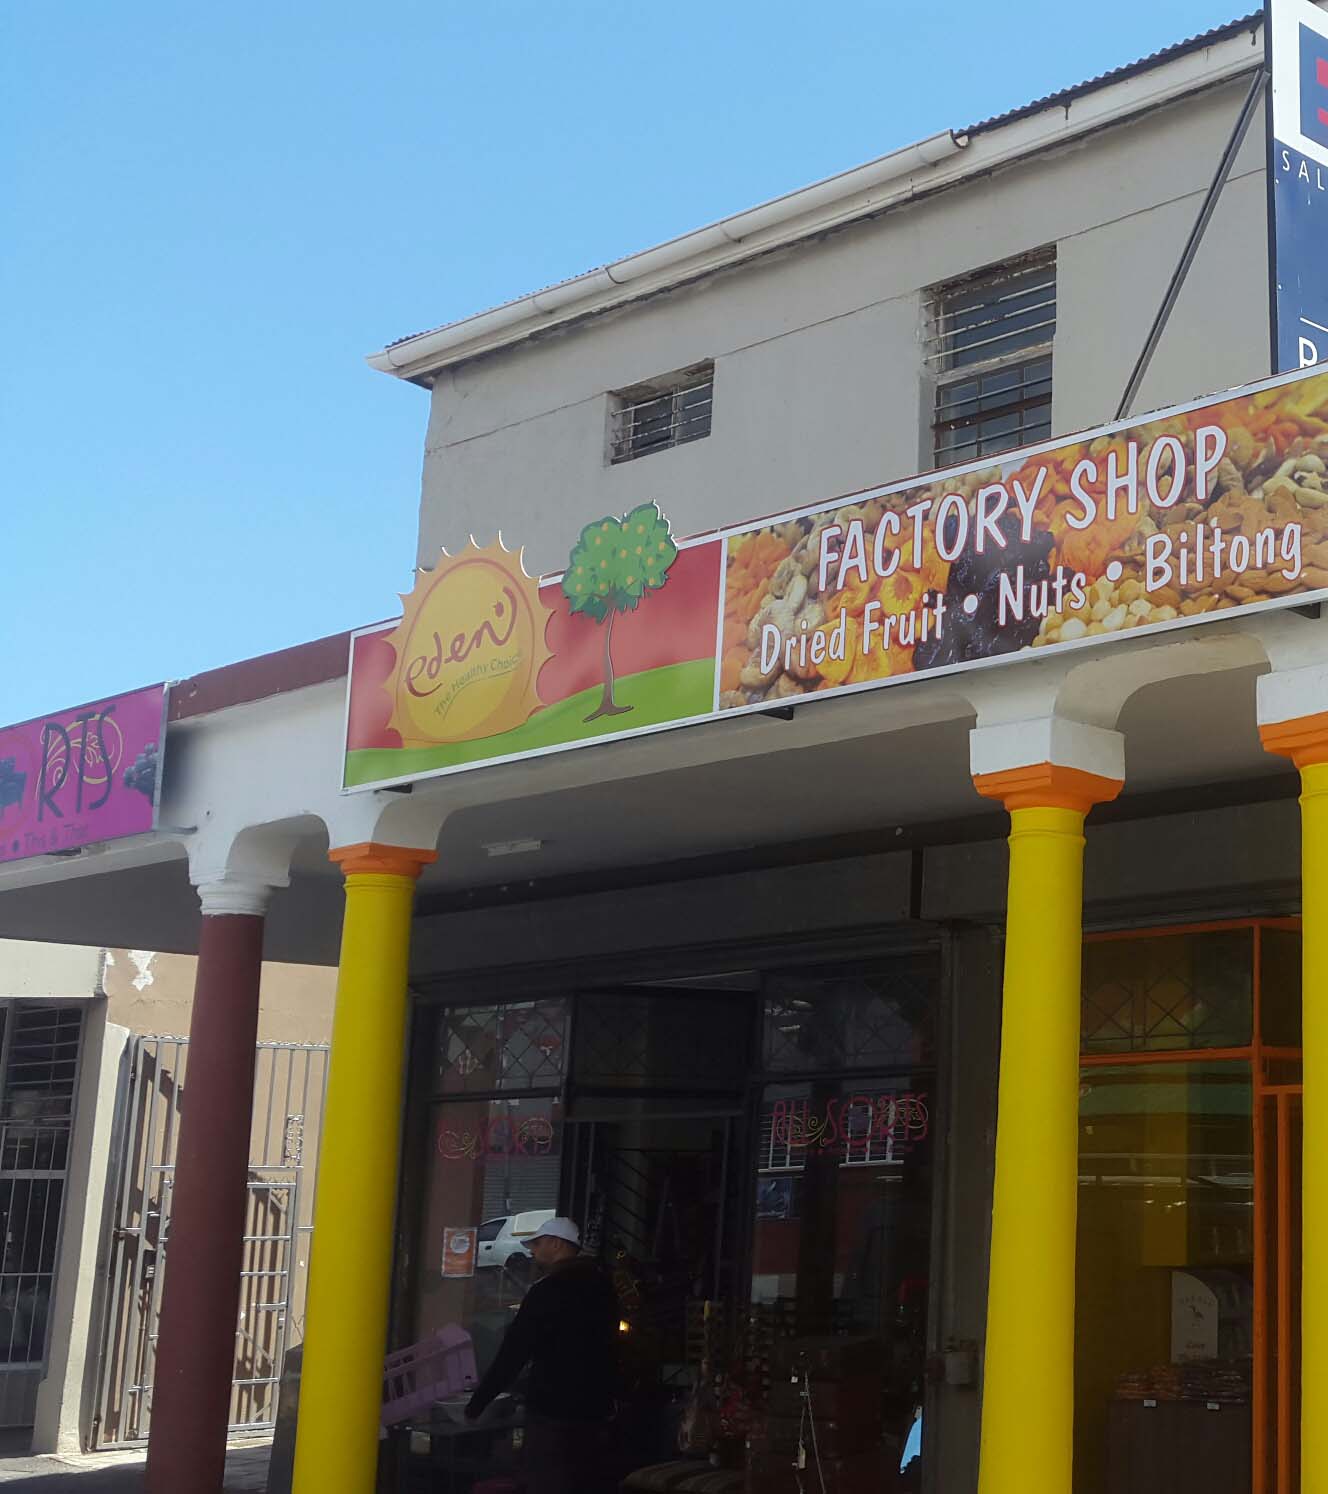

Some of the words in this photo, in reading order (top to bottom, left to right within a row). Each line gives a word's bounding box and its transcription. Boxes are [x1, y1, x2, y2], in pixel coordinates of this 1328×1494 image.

[817, 467, 1048, 592] FACTORY
[1065, 425, 1228, 530] SHOP
[404, 586, 518, 698] eden
[759, 611, 846, 676] Dried
[862, 592, 947, 656] Fruit
[998, 566, 1086, 627] Nuts
[1144, 520, 1302, 593] Biltong
